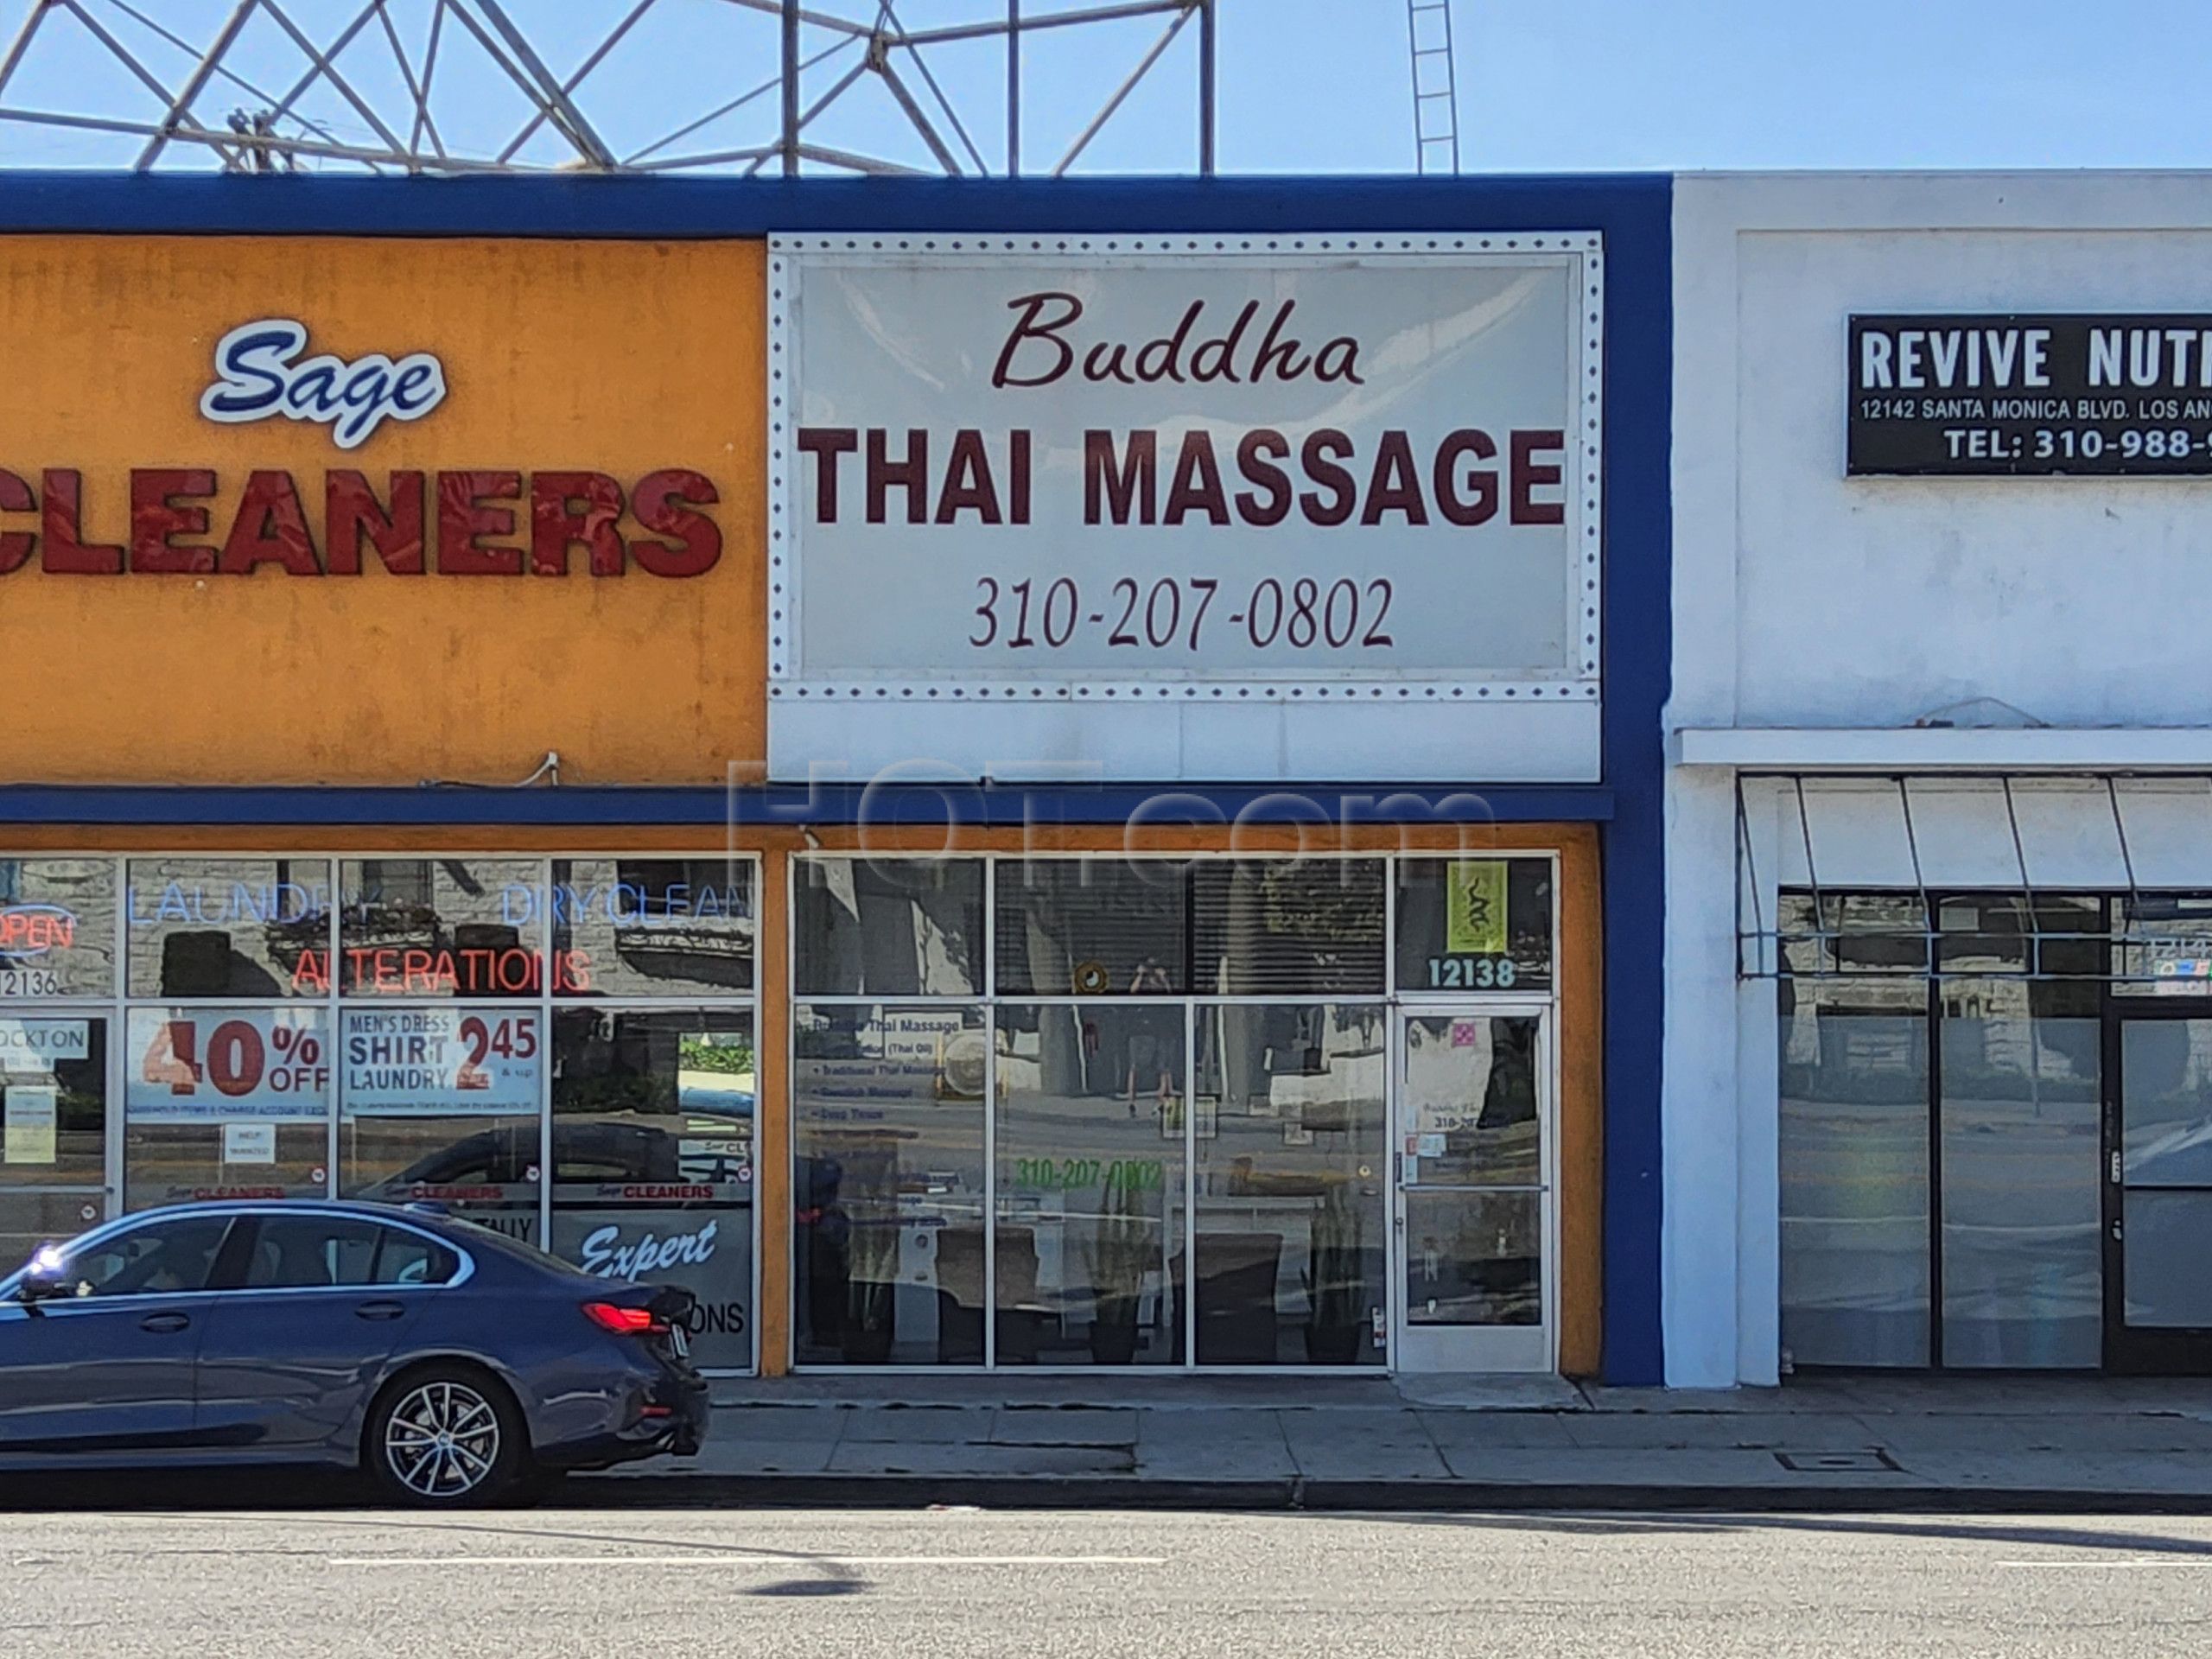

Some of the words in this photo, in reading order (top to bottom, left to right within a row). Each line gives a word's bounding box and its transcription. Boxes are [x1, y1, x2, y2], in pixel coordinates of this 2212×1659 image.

[991, 292, 1365, 388] Buddha
[1862, 329, 2050, 389] REVIVE
[204, 323, 442, 446] Sage
[1860, 400, 1915, 419] 12142
[1922, 400, 1986, 420] SANTA
[1992, 400, 2071, 420] MONICA
[2077, 400, 2130, 420] BLVD.
[2139, 400, 2179, 420] LOS
[2183, 400, 2212, 420] AN
[1944, 430, 2022, 459] TEL:
[798, 429, 1032, 525] THAI
[1084, 429, 1566, 526] MASSAGE
[968, 577, 1395, 651] 310-207-0802
[502, 883, 598, 925] DRY
[0, 971, 57, 995] 2136
[291, 948, 591, 992] ALTERATIONS
[1428, 958, 1516, 987] 12138
[350, 1014, 397, 1033] MEN'S
[402, 1014, 450, 1033] DRESS
[900, 1019, 959, 1034] Massage
[349, 1037, 448, 1065] SHIRT
[269, 1068, 329, 1092] OFF
[350, 1068, 448, 1090] LAUNDRY
[623, 1185, 714, 1199] CLEANERS
[582, 1218, 718, 1284] Expert
